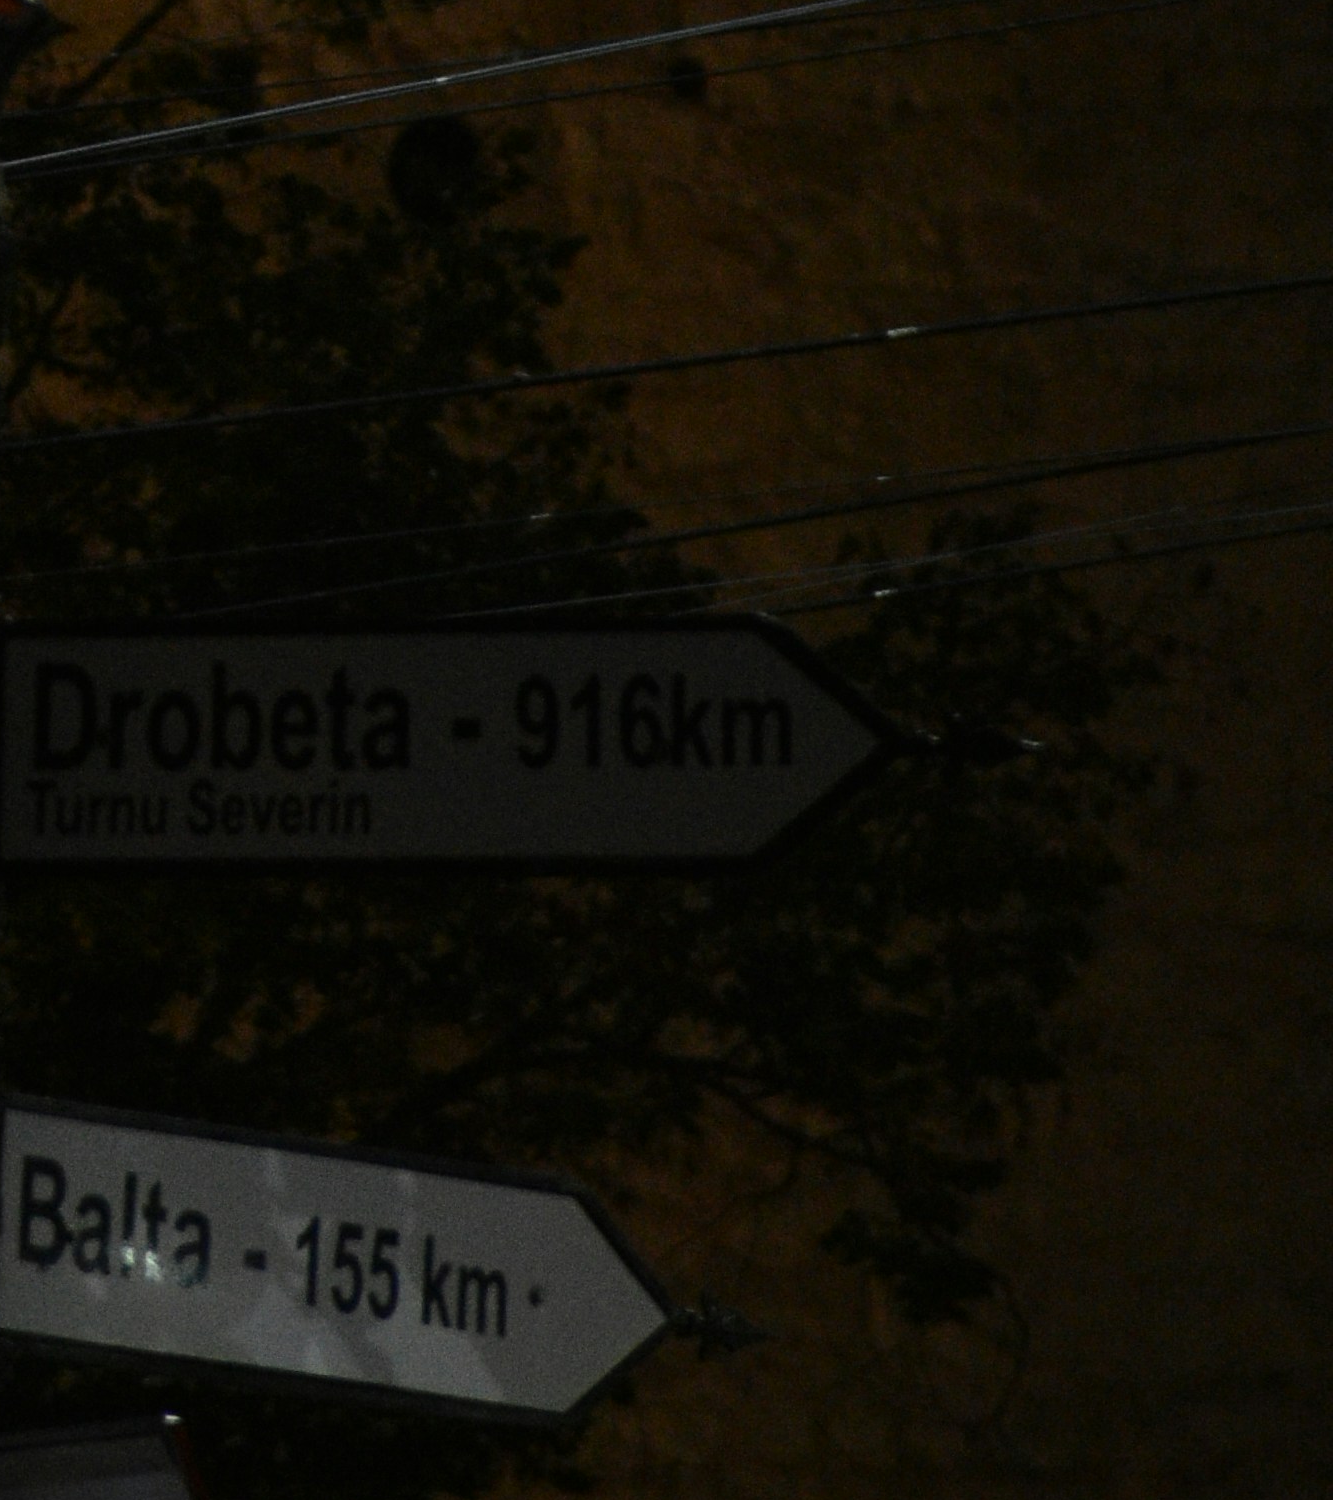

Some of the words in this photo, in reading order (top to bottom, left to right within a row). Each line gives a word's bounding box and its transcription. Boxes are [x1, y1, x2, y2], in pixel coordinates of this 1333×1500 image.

[32, 660, 410, 771] Drobeta
[513, 672, 795, 771] 916km
[28, 781, 169, 837] Turnu
[187, 779, 373, 837] Severin
[18, 1155, 211, 1287] Balta
[296, 1215, 401, 1320] 155
[421, 1234, 507, 1338] km
